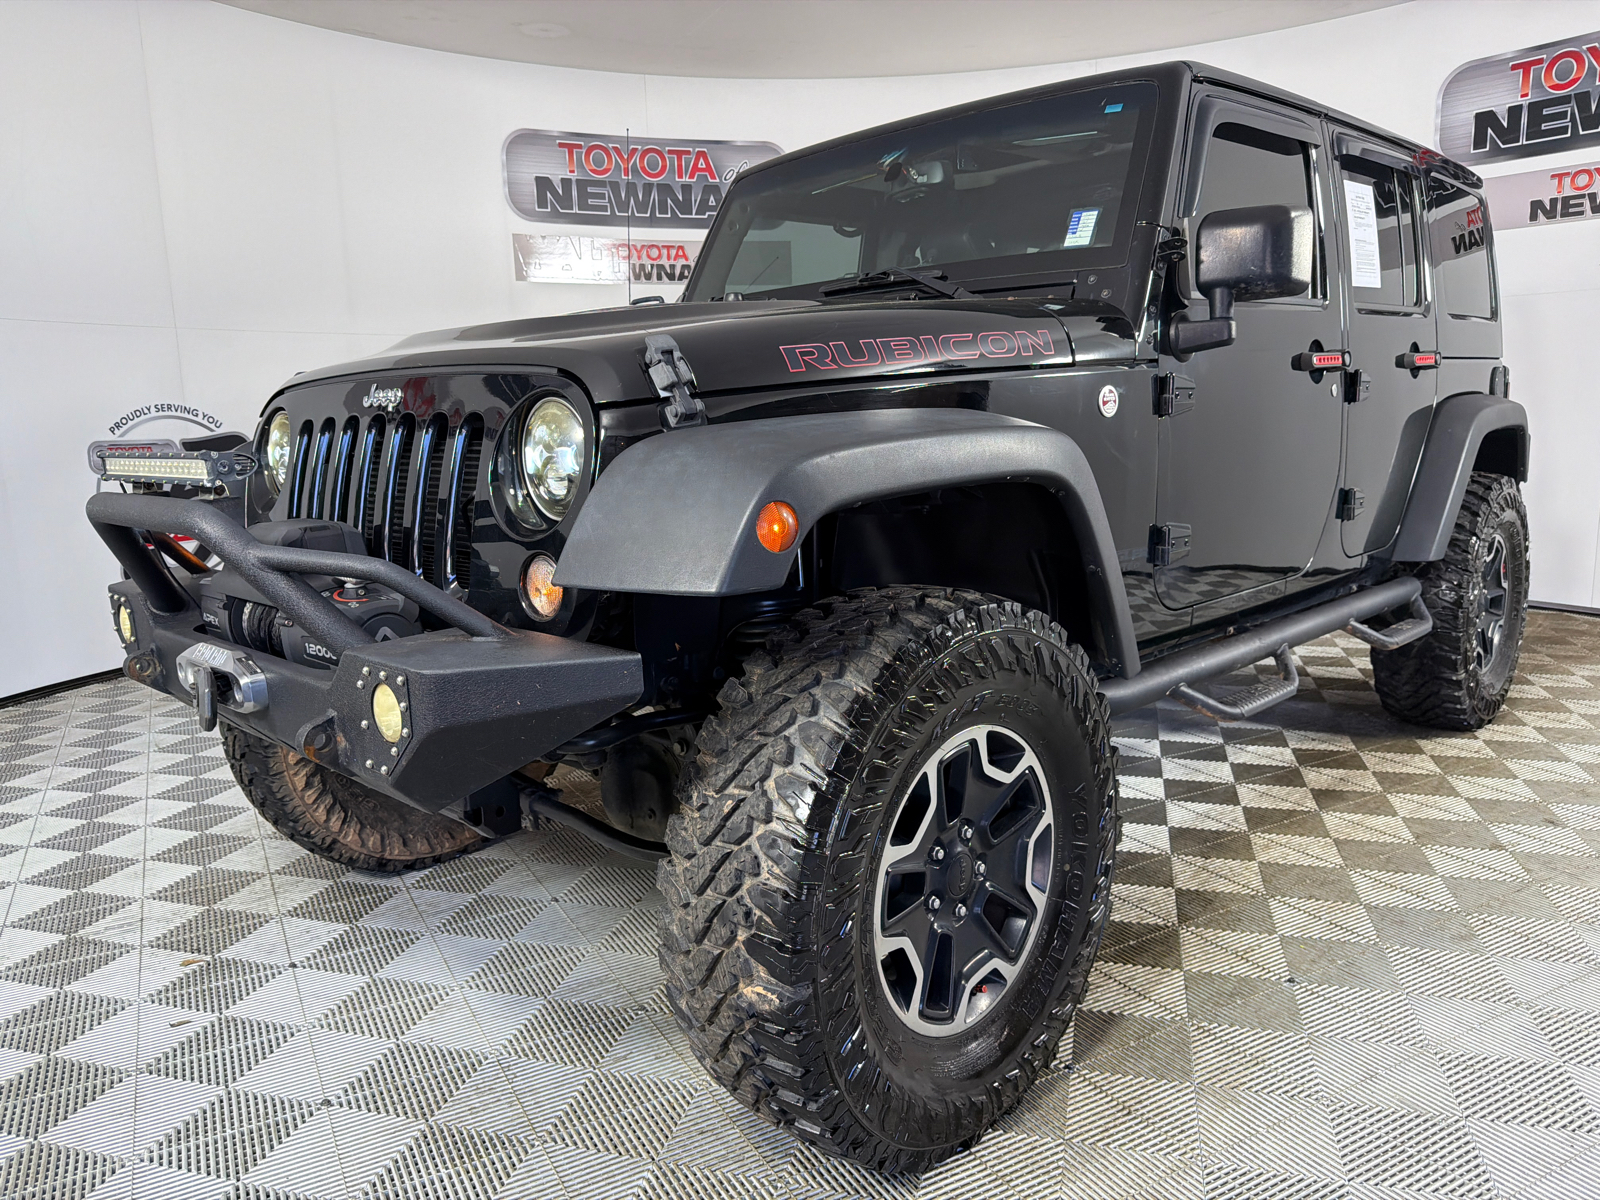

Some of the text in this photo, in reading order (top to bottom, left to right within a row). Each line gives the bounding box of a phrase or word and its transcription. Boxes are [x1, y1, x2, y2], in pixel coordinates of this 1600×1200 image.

[556, 140, 719, 182] TOYOTA
[606, 242, 689, 262] TOYOTA
[779, 330, 1055, 373] RUBICON
[362, 383, 403, 412] Jeep
[108, 403, 223, 436] PROUDLY SERVING YOU
